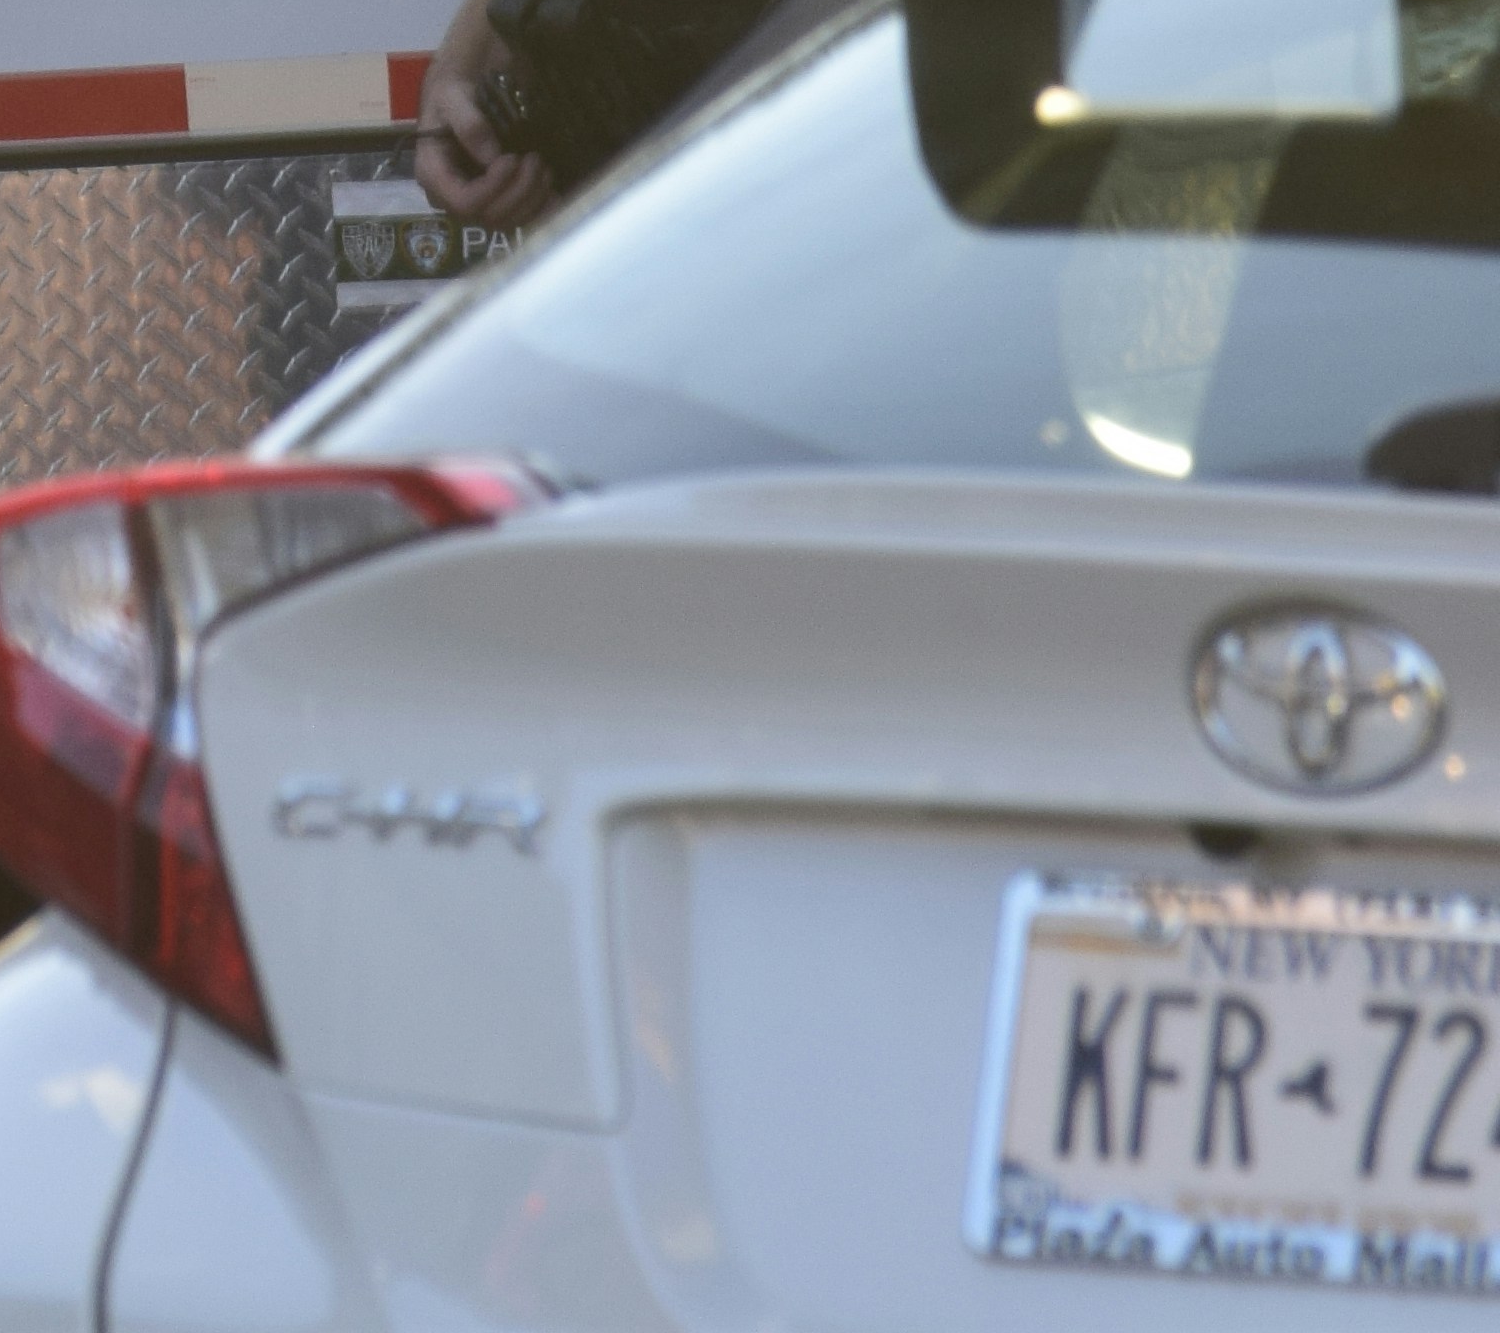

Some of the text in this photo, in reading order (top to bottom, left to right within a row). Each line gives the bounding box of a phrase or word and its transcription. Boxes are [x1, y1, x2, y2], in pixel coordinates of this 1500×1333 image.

[1188, 925, 1500, 994] NEW YOR
[1054, 981, 1270, 1173] KFR
[1184, 1219, 1326, 1275] Auto
